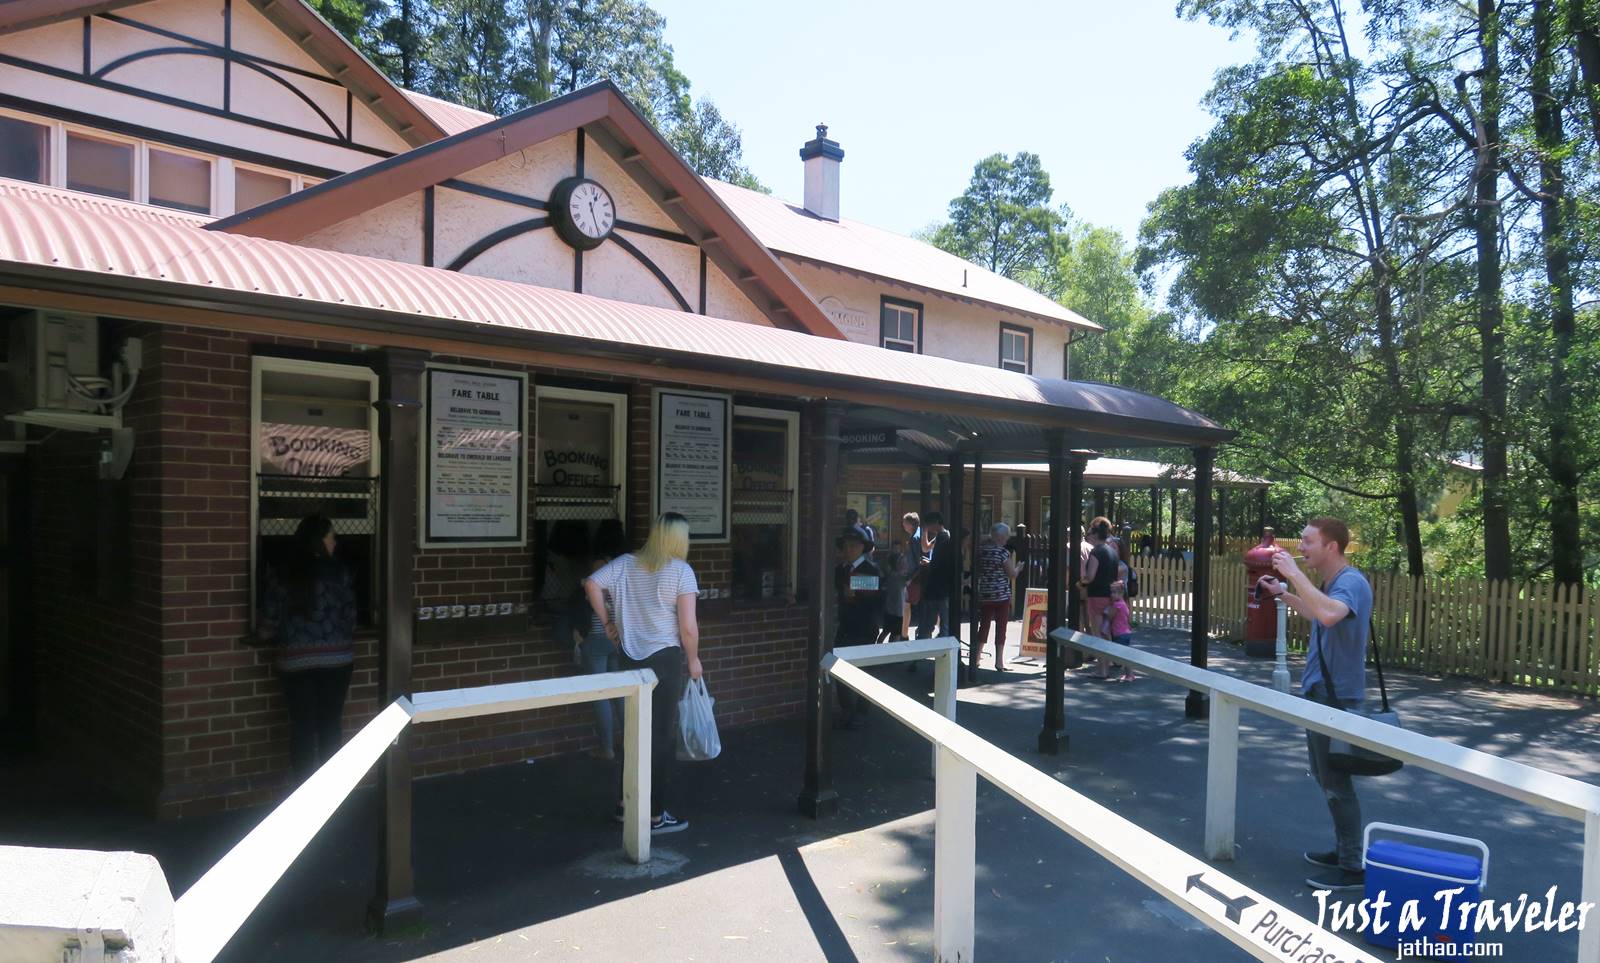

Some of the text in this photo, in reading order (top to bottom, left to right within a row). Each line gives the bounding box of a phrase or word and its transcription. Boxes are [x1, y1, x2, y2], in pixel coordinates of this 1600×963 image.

[452, 389, 500, 401] FARE TABLE
[676, 408, 712, 419] FARE TABLE
[842, 432, 886, 444] BOOKING
